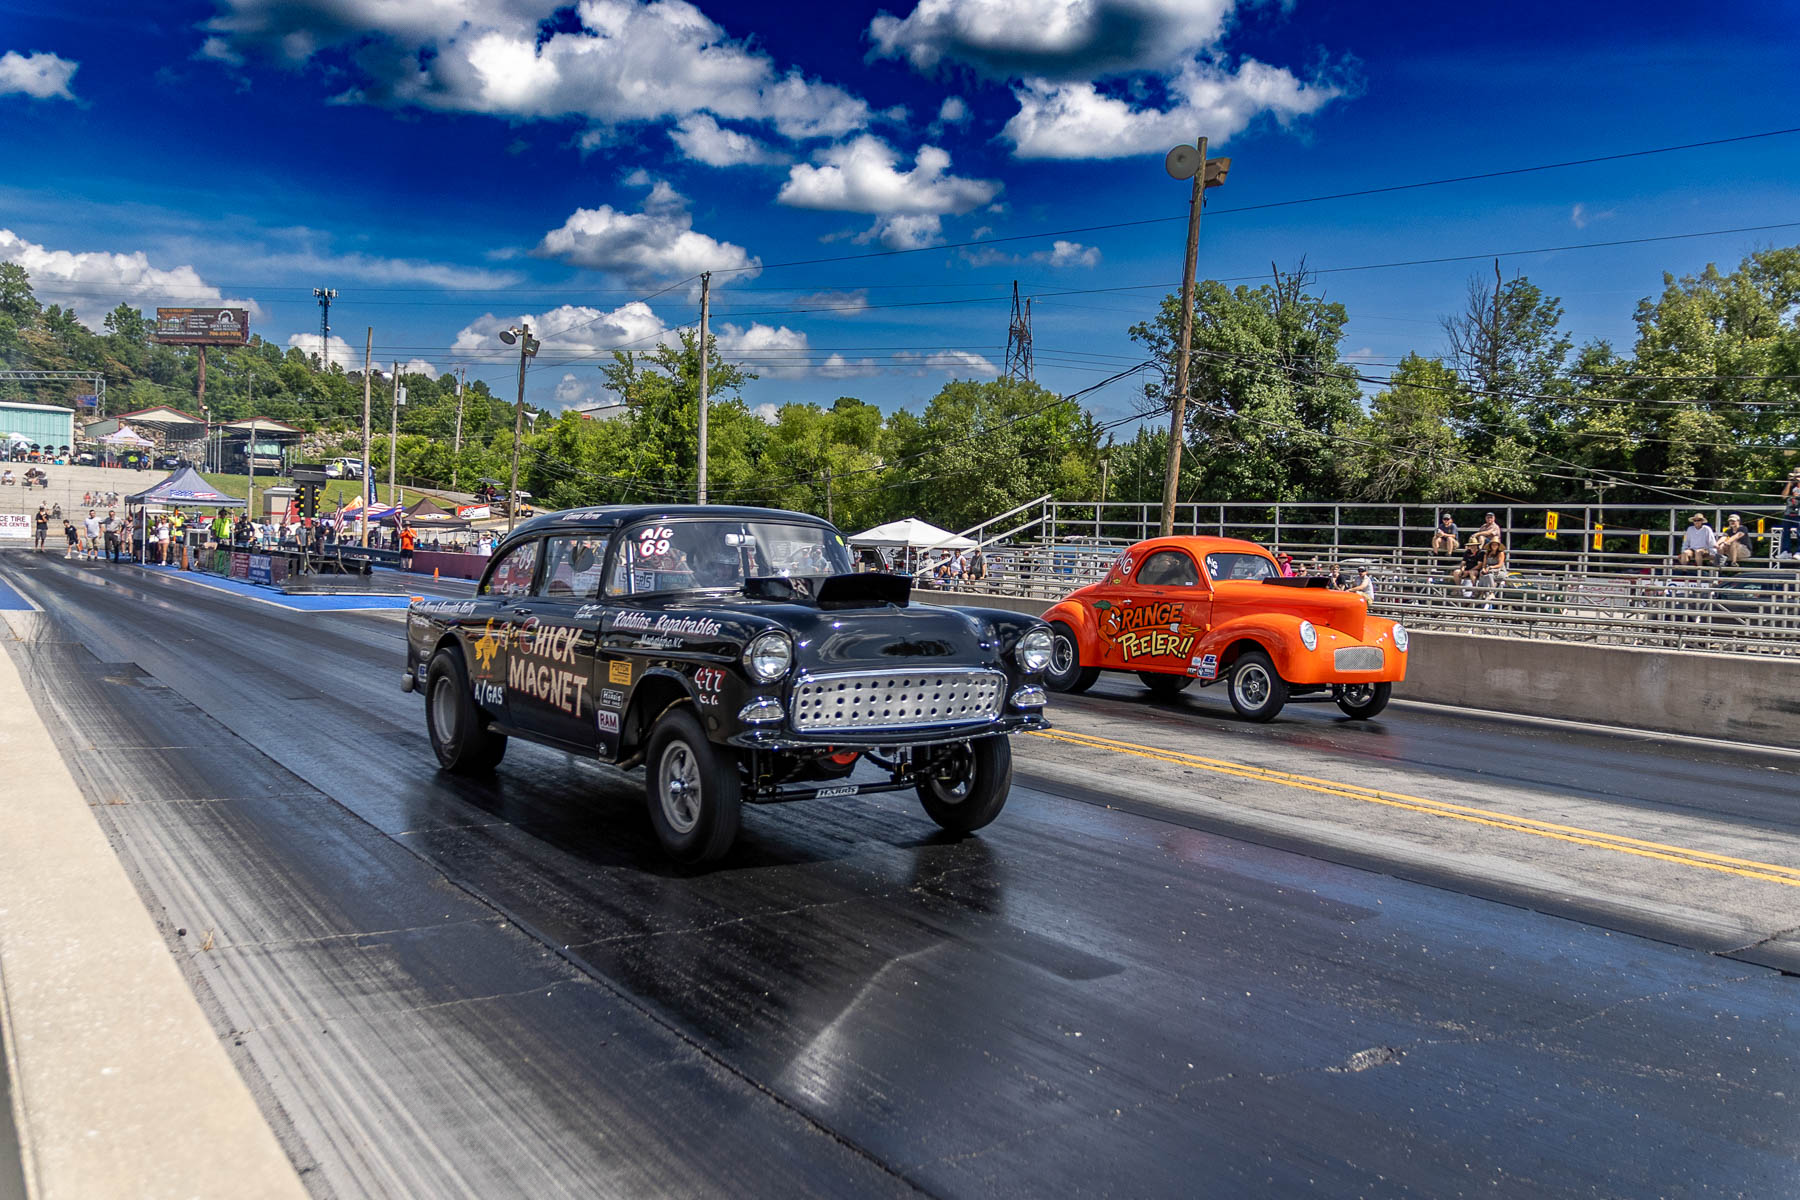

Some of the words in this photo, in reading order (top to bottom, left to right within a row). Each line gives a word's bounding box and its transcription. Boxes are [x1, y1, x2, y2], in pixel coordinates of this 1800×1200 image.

[639, 526, 674, 540] A/G
[639, 539, 671, 557] 69
[613, 611, 652, 630] Robbins
[655, 614, 722, 637] Repairables
[1099, 602, 1184, 636] ORANGE
[519, 616, 583, 665] CHICK
[1117, 630, 1194, 662] PEELER!!
[509, 655, 589, 717] MAGNET
[695, 666, 727, 692] 477
[474, 679, 503, 706] A/GAS
[600, 713, 617, 728] RAM
